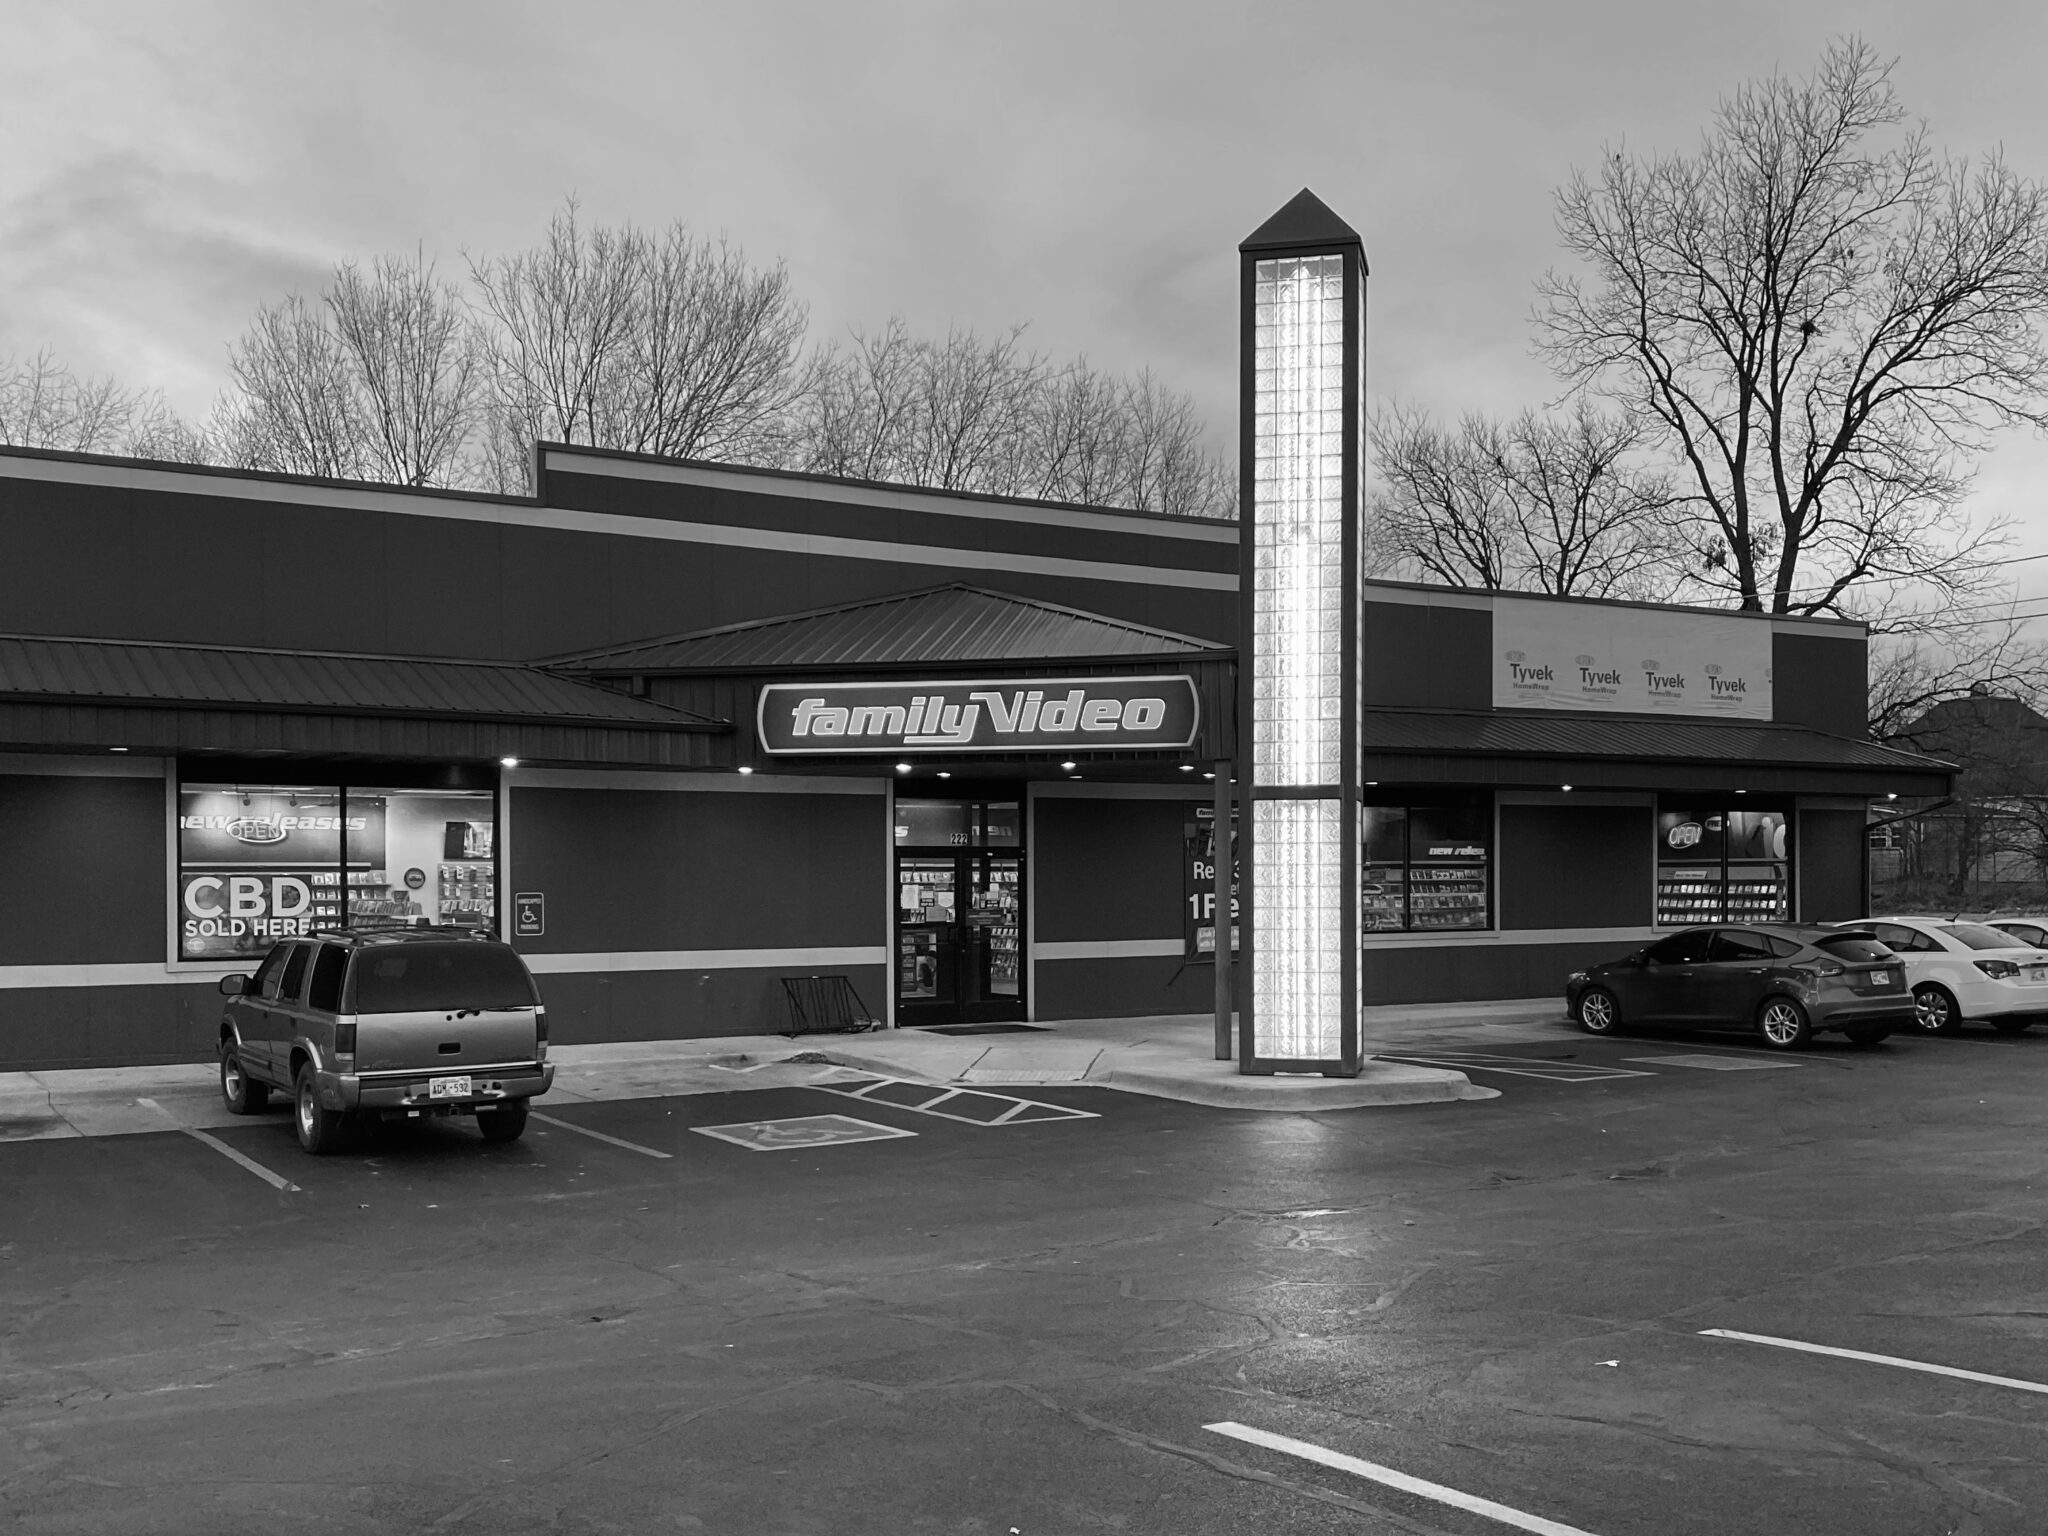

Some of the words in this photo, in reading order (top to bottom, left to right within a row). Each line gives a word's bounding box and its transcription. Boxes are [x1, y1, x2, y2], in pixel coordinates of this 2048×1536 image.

[1510, 663, 1554, 683] Tyvek
[1579, 667, 1621, 687] Tyvek
[1645, 672, 1685, 690] Tyvek
[1708, 676, 1746, 694] Tyvek
[792, 697, 980, 743] family
[970, 690, 1166, 732] Video
[230, 824, 281, 839] OPEN
[951, 833, 968, 845] 222
[1669, 826, 1701, 845] OPEN
[184, 876, 311, 918] CBD
[185, 919, 246, 937] SOLD
[253, 918, 311, 936] HERE
